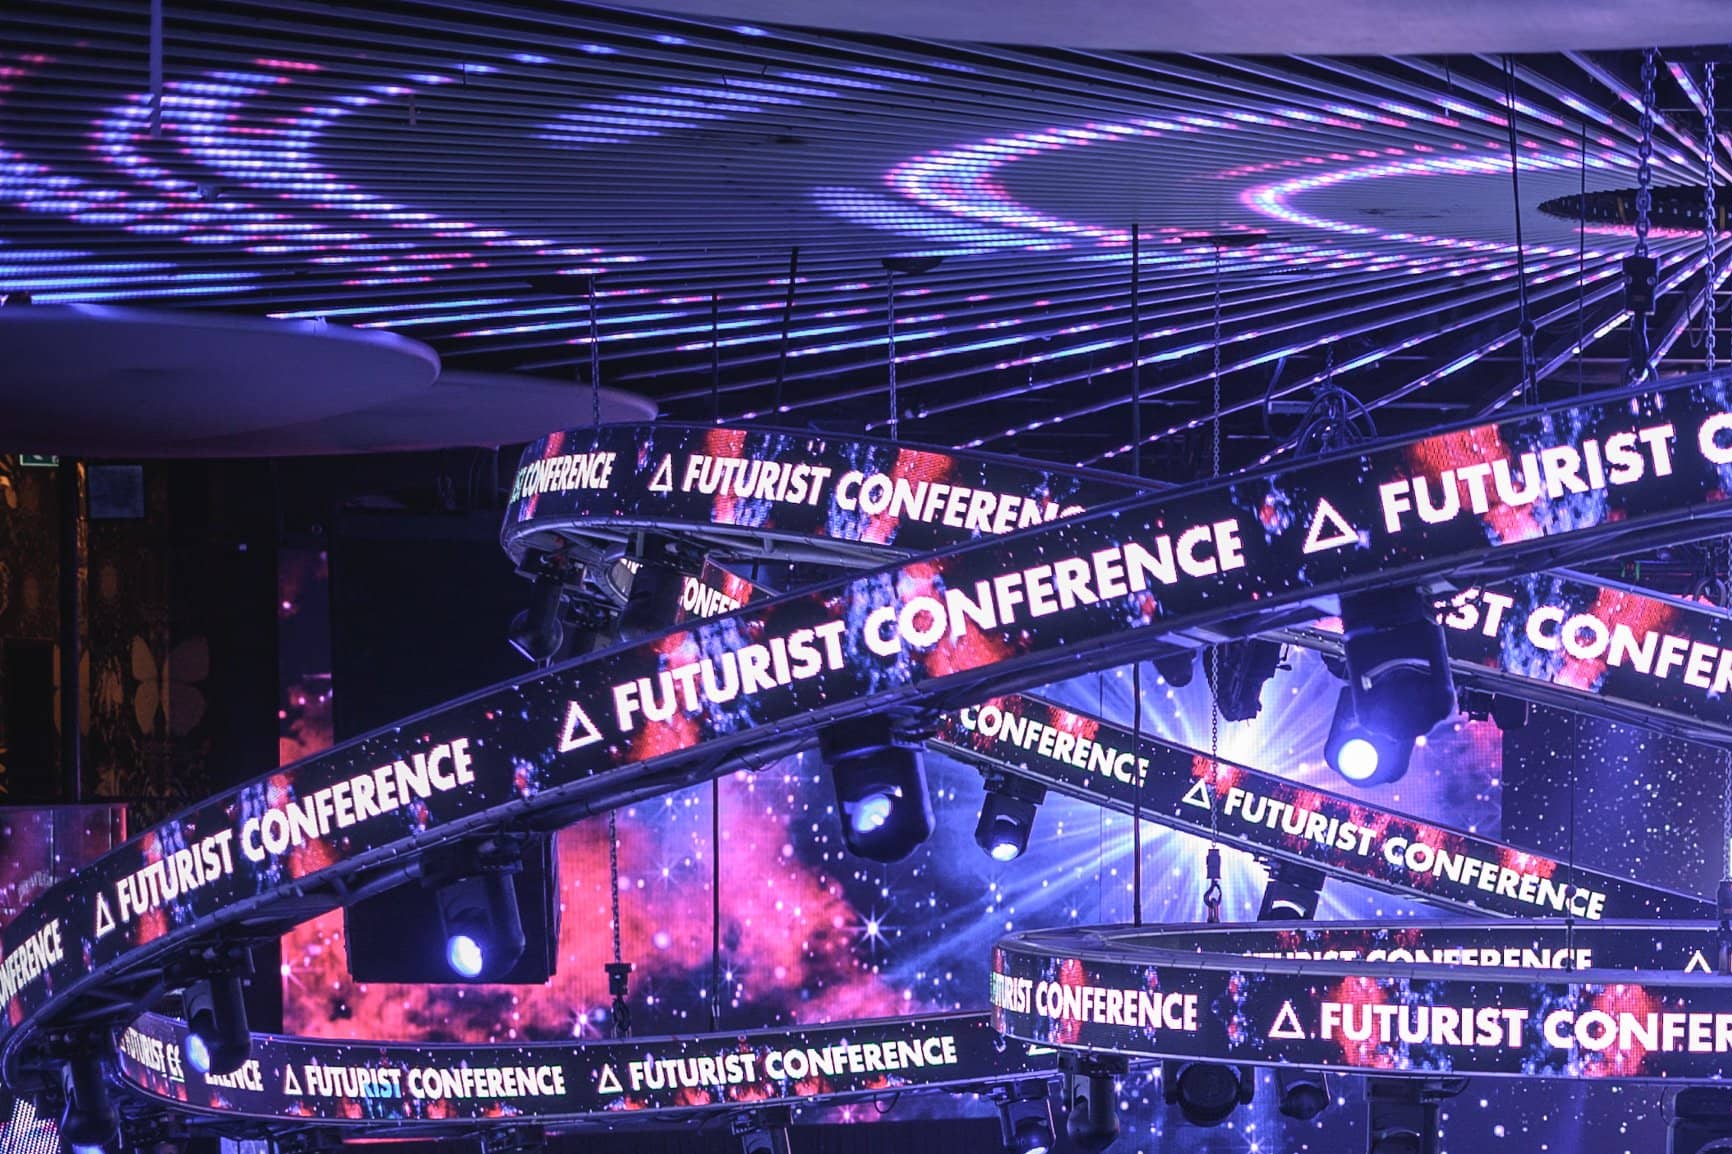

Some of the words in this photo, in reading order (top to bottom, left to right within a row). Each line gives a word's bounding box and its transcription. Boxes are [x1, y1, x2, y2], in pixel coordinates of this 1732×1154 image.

[522, 452, 616, 497] CONFERENCE
[682, 453, 831, 506] FUTURIST
[835, 469, 1086, 534] CONFEREN
[1378, 424, 1675, 534] FUTURIST
[611, 619, 847, 733] FUTURIST
[863, 517, 1246, 657] CONFERENCE
[958, 703, 1149, 787] CONFERENCE
[116, 828, 234, 923] FUTURIST
[240, 737, 475, 863] CONFERENCE
[1223, 788, 1377, 858] FUTURIST
[1384, 836, 1608, 920] CONFERENCE
[0, 918, 64, 1008] NFERENCE
[1036, 980, 1198, 1031] CONFERENCE
[1319, 1000, 1530, 1048] FUTURIST
[304, 1064, 402, 1098] FUTURIST
[408, 1066, 565, 1098] CONFERENCE
[628, 1053, 757, 1090] FUTURIST
[765, 1036, 957, 1081] CONFERENCE
